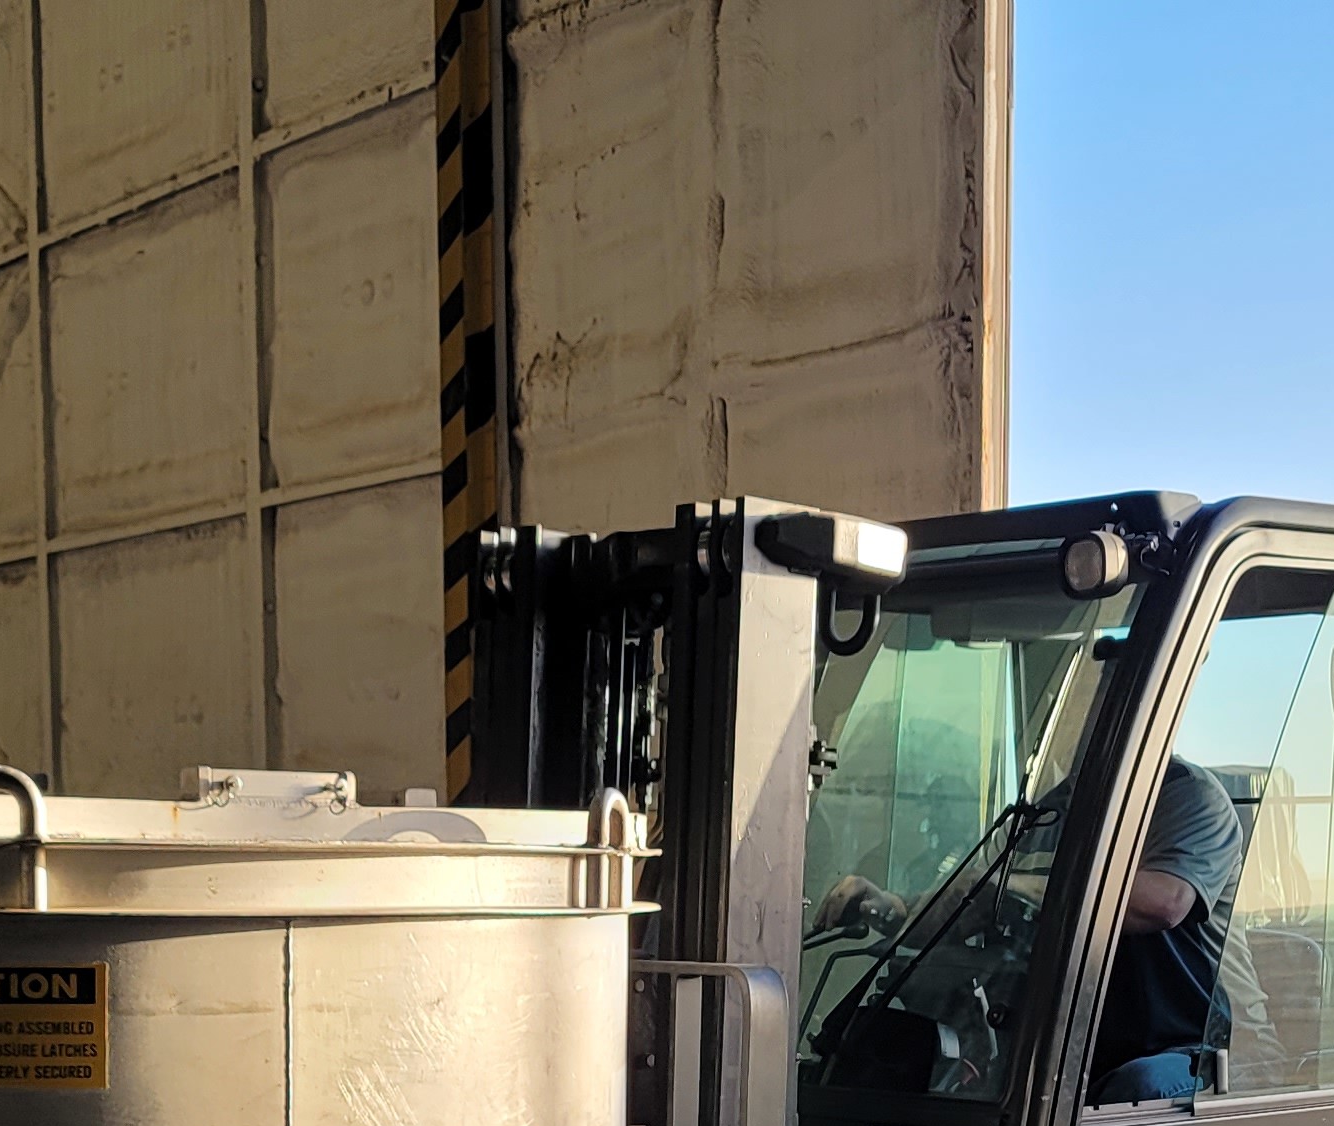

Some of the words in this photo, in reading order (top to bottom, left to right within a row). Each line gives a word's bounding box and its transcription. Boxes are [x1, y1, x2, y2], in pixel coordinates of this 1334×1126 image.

[17, 1020, 95, 1035] ASSEMBLED
[40, 1043, 98, 1058] LATCHES
[34, 1065, 92, 1080] SECURED
